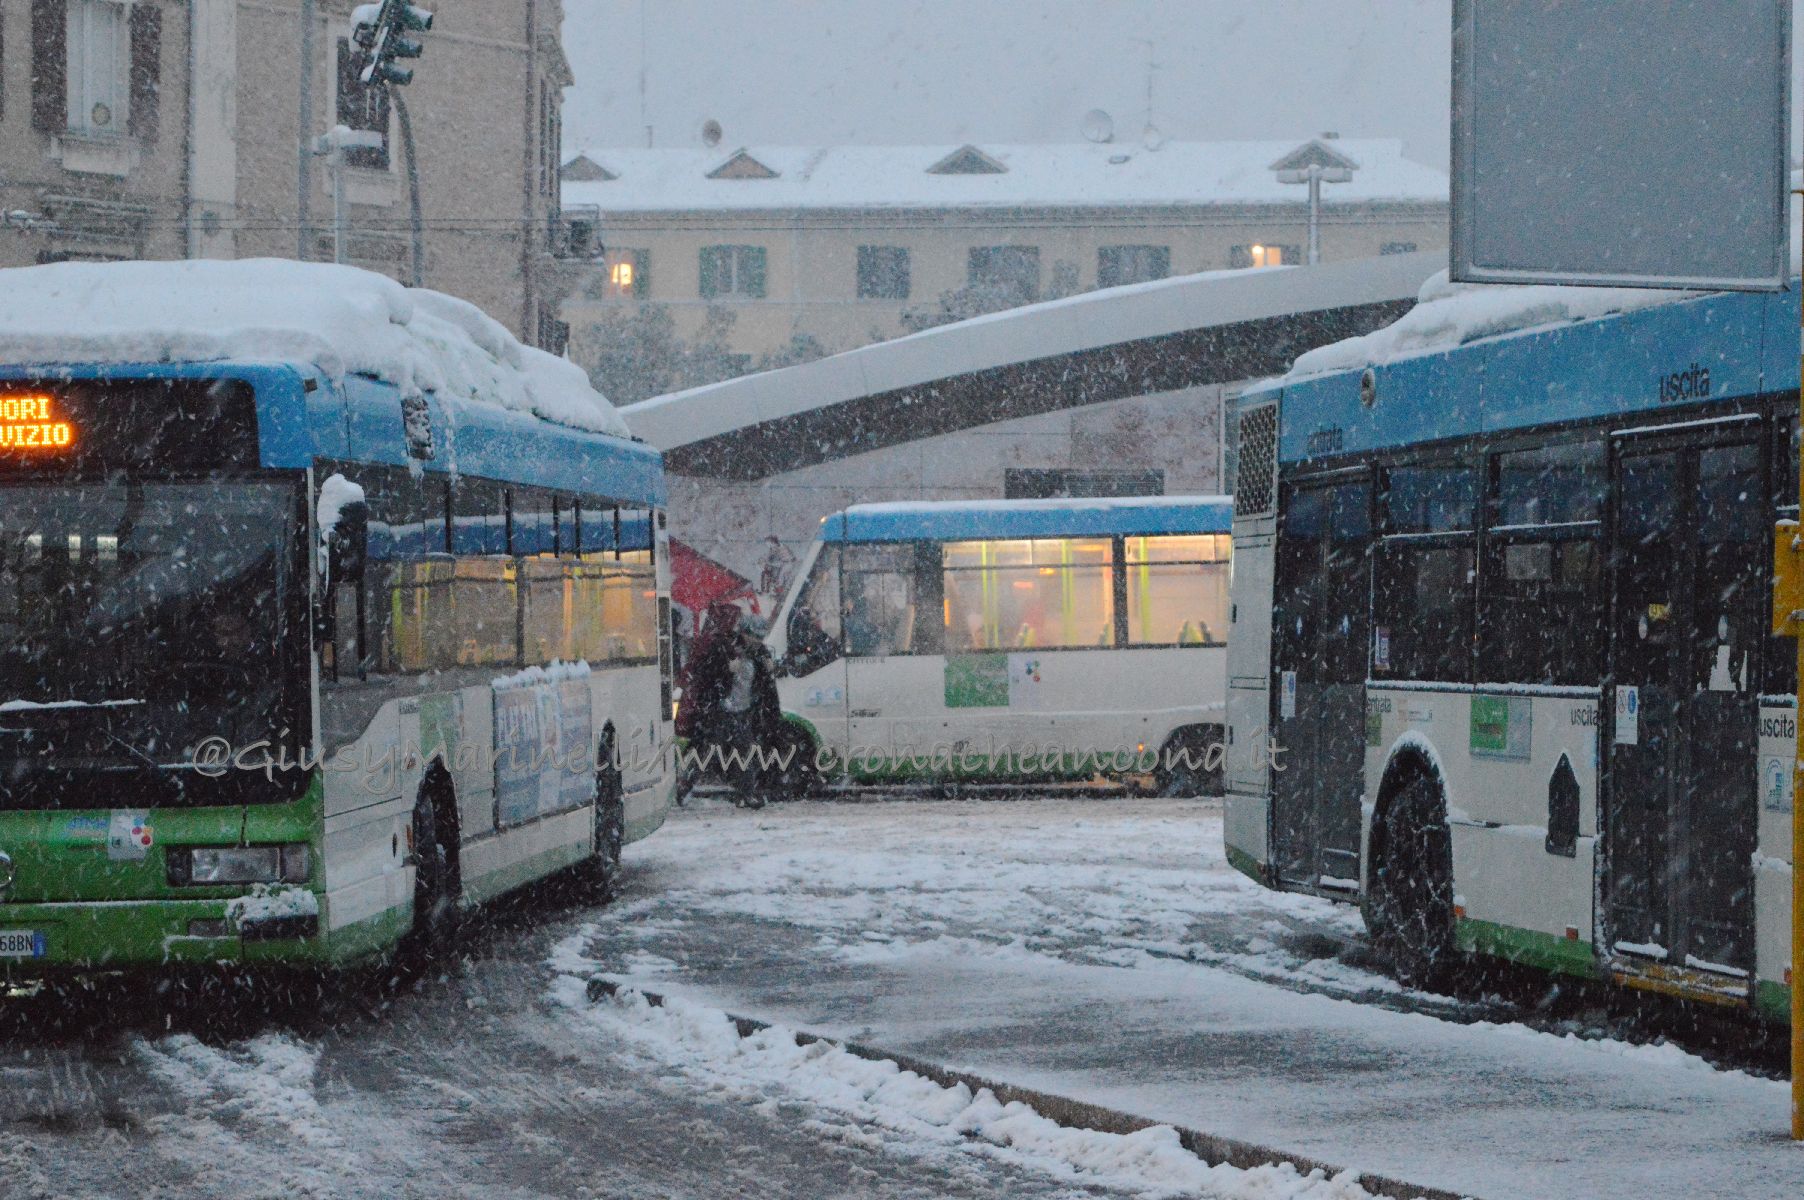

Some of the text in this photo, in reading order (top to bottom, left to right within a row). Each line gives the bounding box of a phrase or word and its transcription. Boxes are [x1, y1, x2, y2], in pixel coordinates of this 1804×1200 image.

[1660, 362, 1710, 403] uscita
[0, 398, 49, 420] ORI
[1571, 705, 1599, 726] uscita
[1759, 714, 1795, 739] uscita
